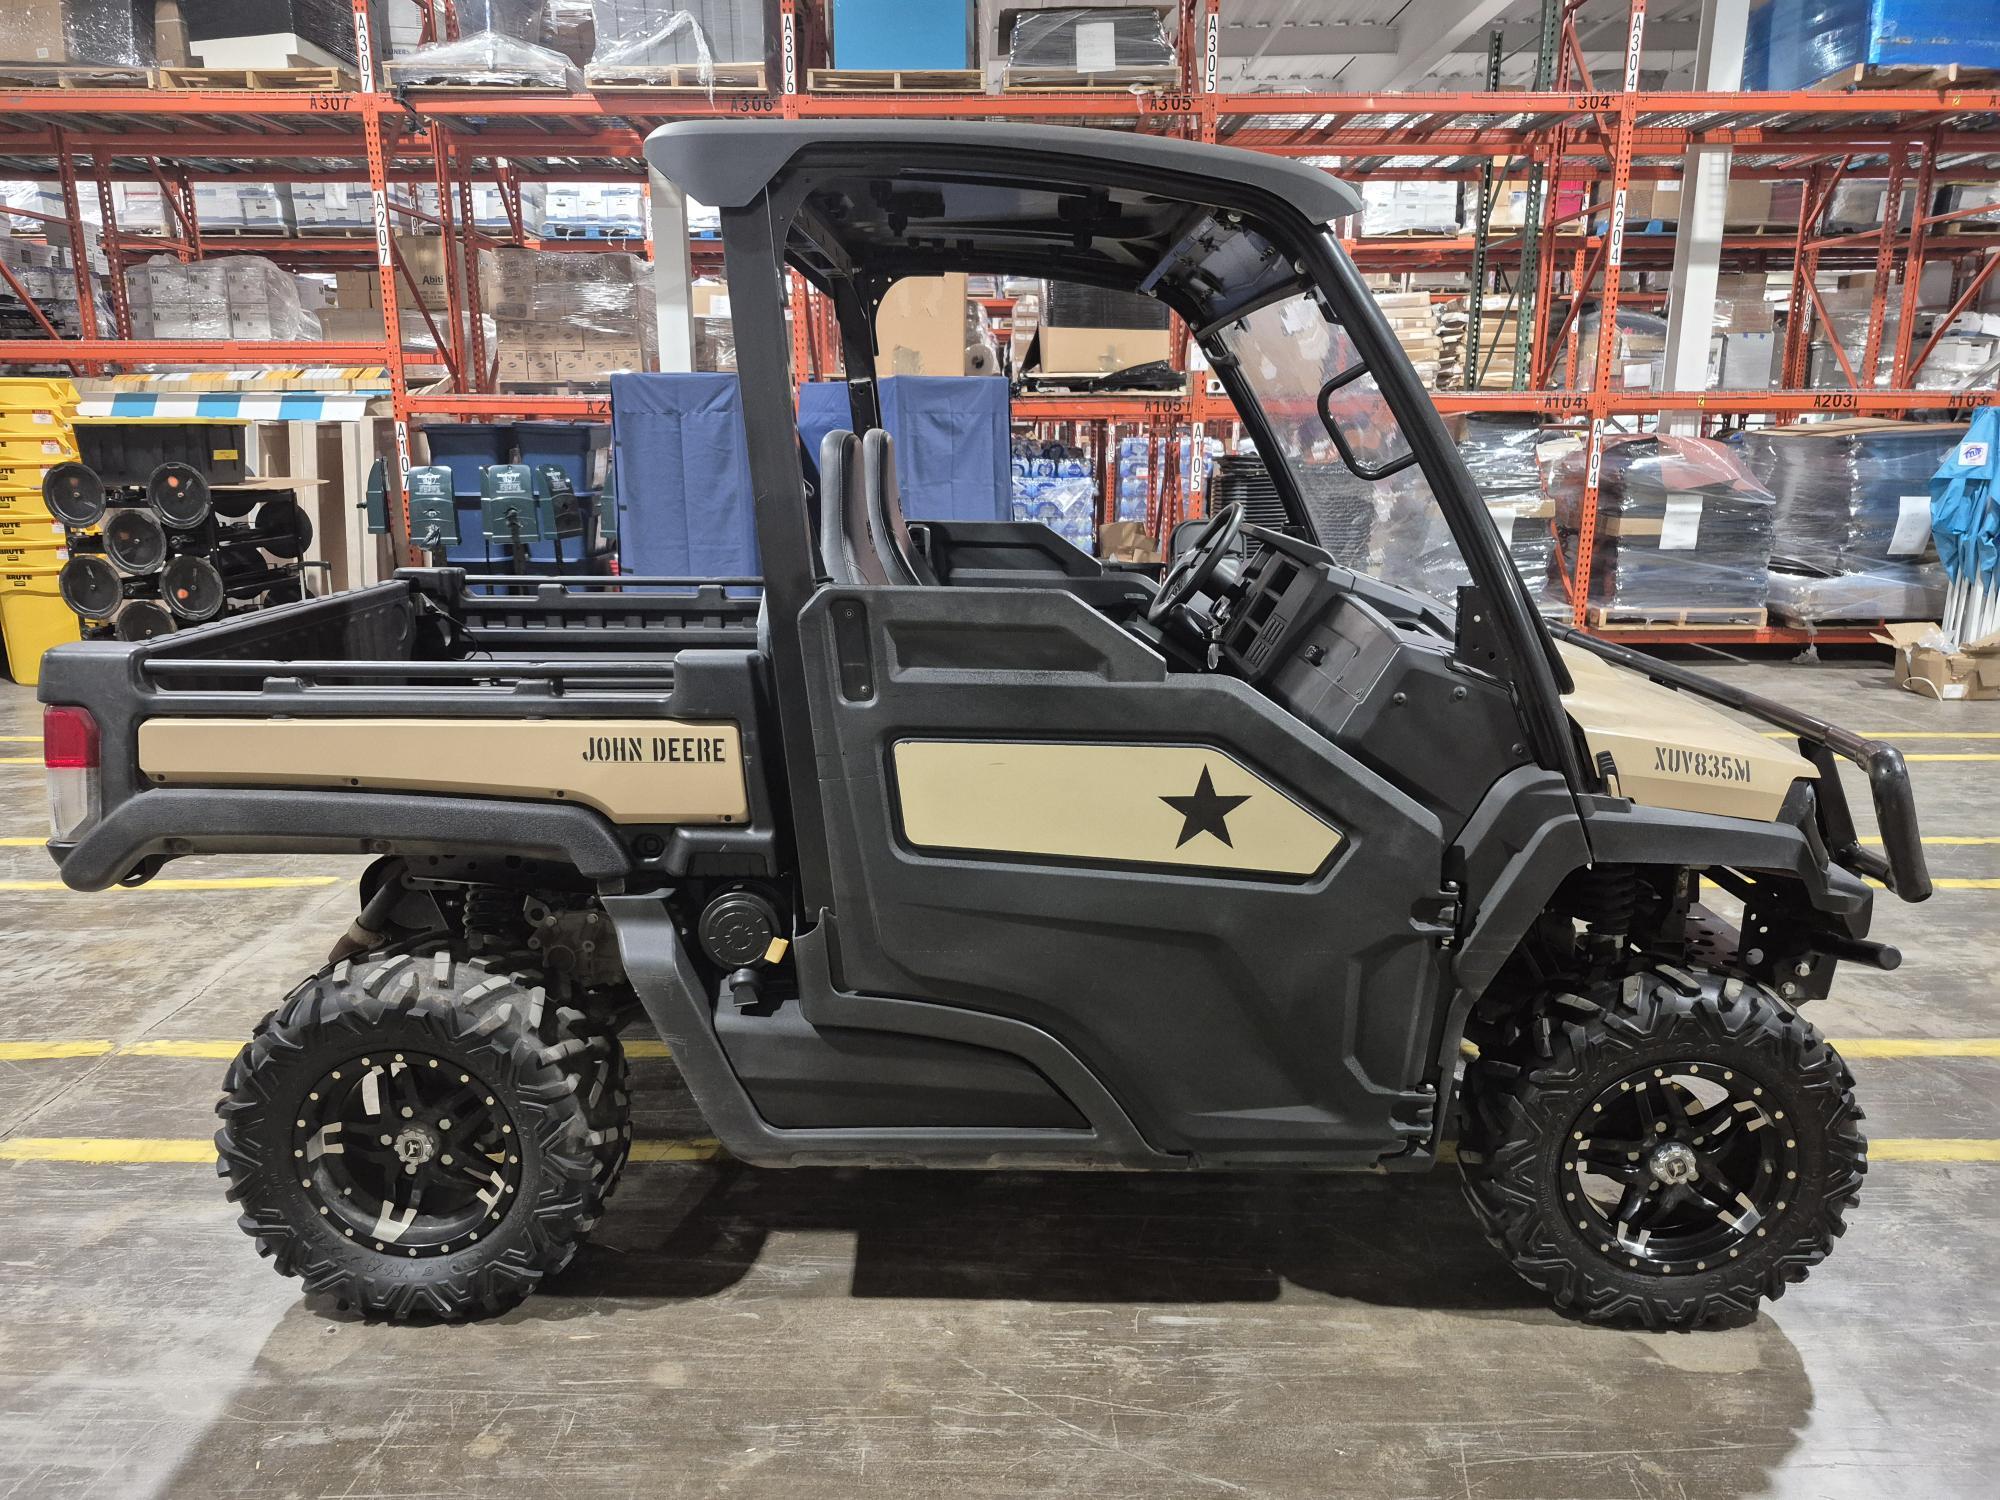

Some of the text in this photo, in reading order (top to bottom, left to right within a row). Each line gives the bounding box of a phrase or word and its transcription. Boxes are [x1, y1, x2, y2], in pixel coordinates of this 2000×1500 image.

[358, 14, 370, 91] A307
[784, 15, 794, 93] A306
[1207, 15, 1217, 92] A305
[1628, 14, 1642, 90] A304
[310, 96, 349, 111] A307
[731, 96, 773, 112] A306
[1150, 95, 1192, 111] A305
[1568, 95, 1611, 109] A304
[376, 192, 388, 264] A207
[1611, 193, 1624, 264] A204
[587, 401, 611, 414] A2
[1145, 400, 1181, 412] A105
[1545, 396, 1581, 409] A104
[1814, 394, 1852, 408] A203
[398, 422, 409, 489] A107
[1193, 424, 1201, 490] A105
[1589, 420, 1601, 486] A104
[583, 737, 725, 762] JOHN DEERE
[1655, 746, 1750, 783] XUV835M
